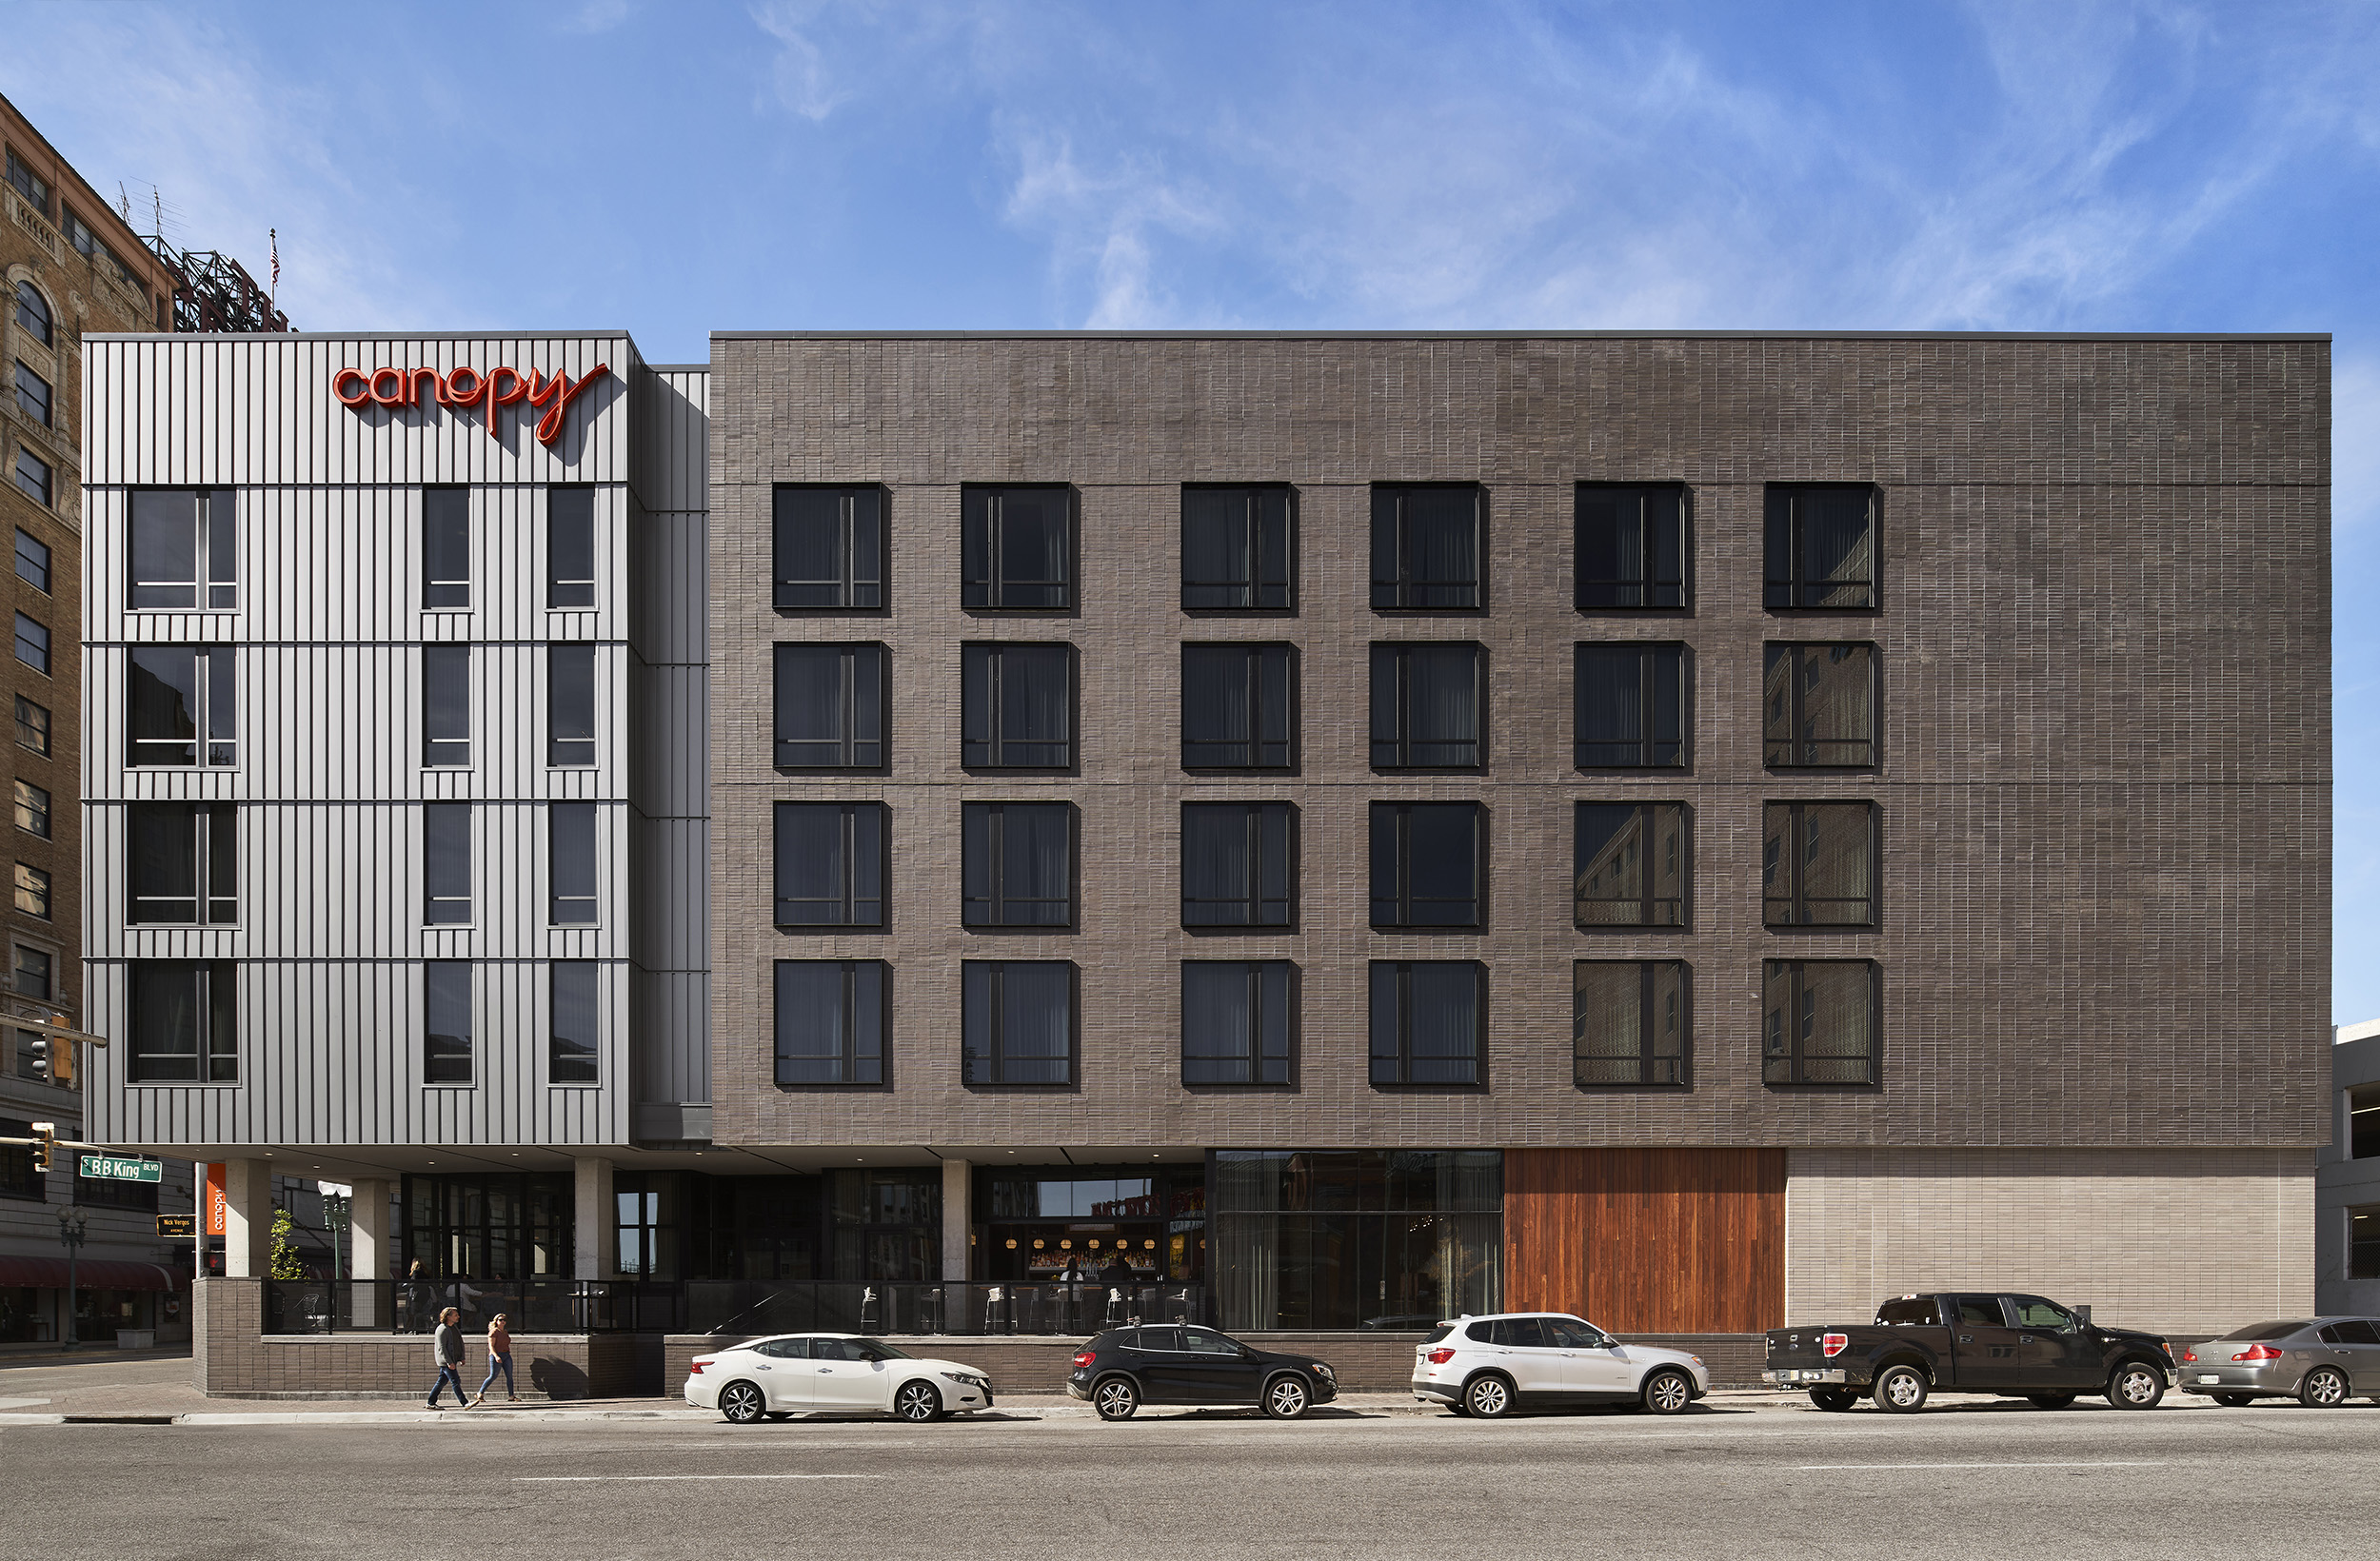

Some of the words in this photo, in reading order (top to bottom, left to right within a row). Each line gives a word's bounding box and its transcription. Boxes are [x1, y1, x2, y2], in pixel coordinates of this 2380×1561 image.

[333, 363, 608, 445] canopy
[83, 1158, 89, 1167] S
[143, 1163, 159, 1172] BLVD
